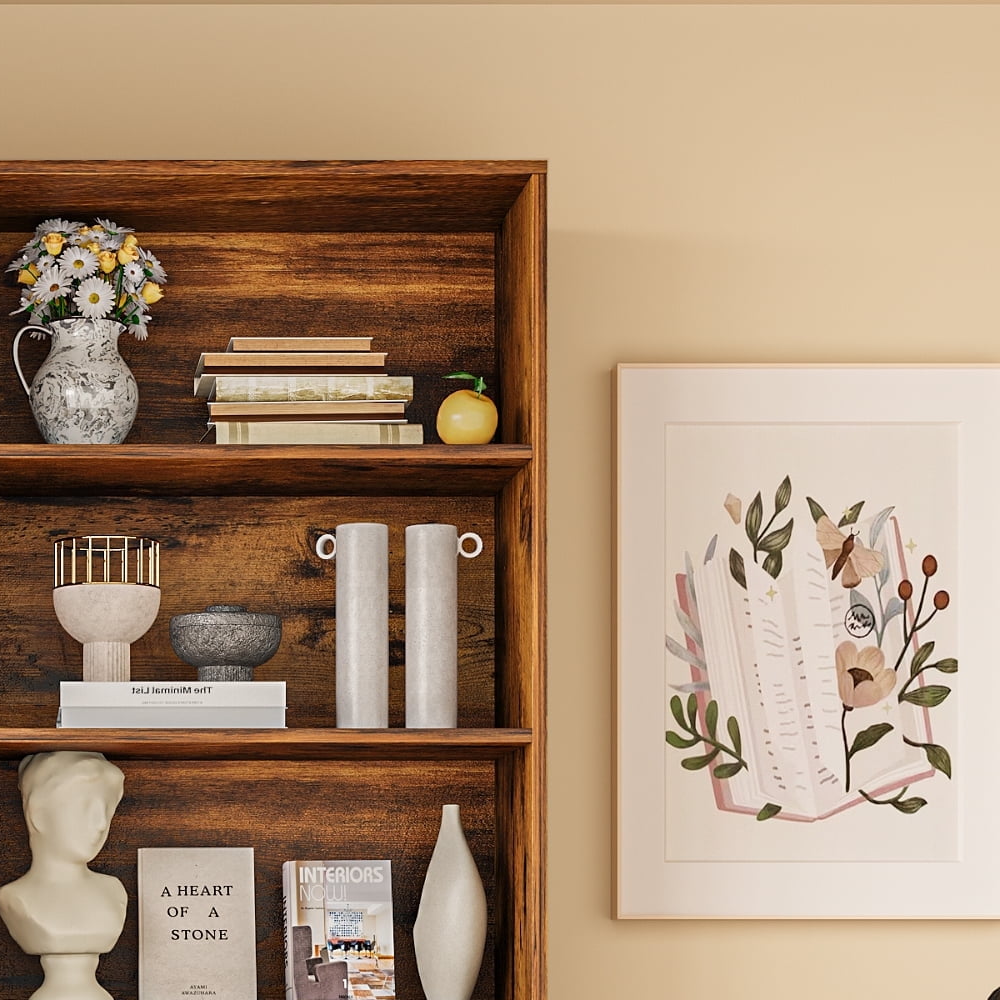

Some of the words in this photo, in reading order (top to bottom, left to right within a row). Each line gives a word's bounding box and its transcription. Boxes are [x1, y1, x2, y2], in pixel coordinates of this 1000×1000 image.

[300, 866, 384, 884] INTERIORS
[160, 886, 172, 898] A
[178, 886, 234, 896] HEART
[300, 884, 348, 902] NOW!
[167, 906, 189, 918] OF
[208, 906, 220, 918] A
[171, 929, 229, 940] STONE
[342, 978, 348, 989] 1
